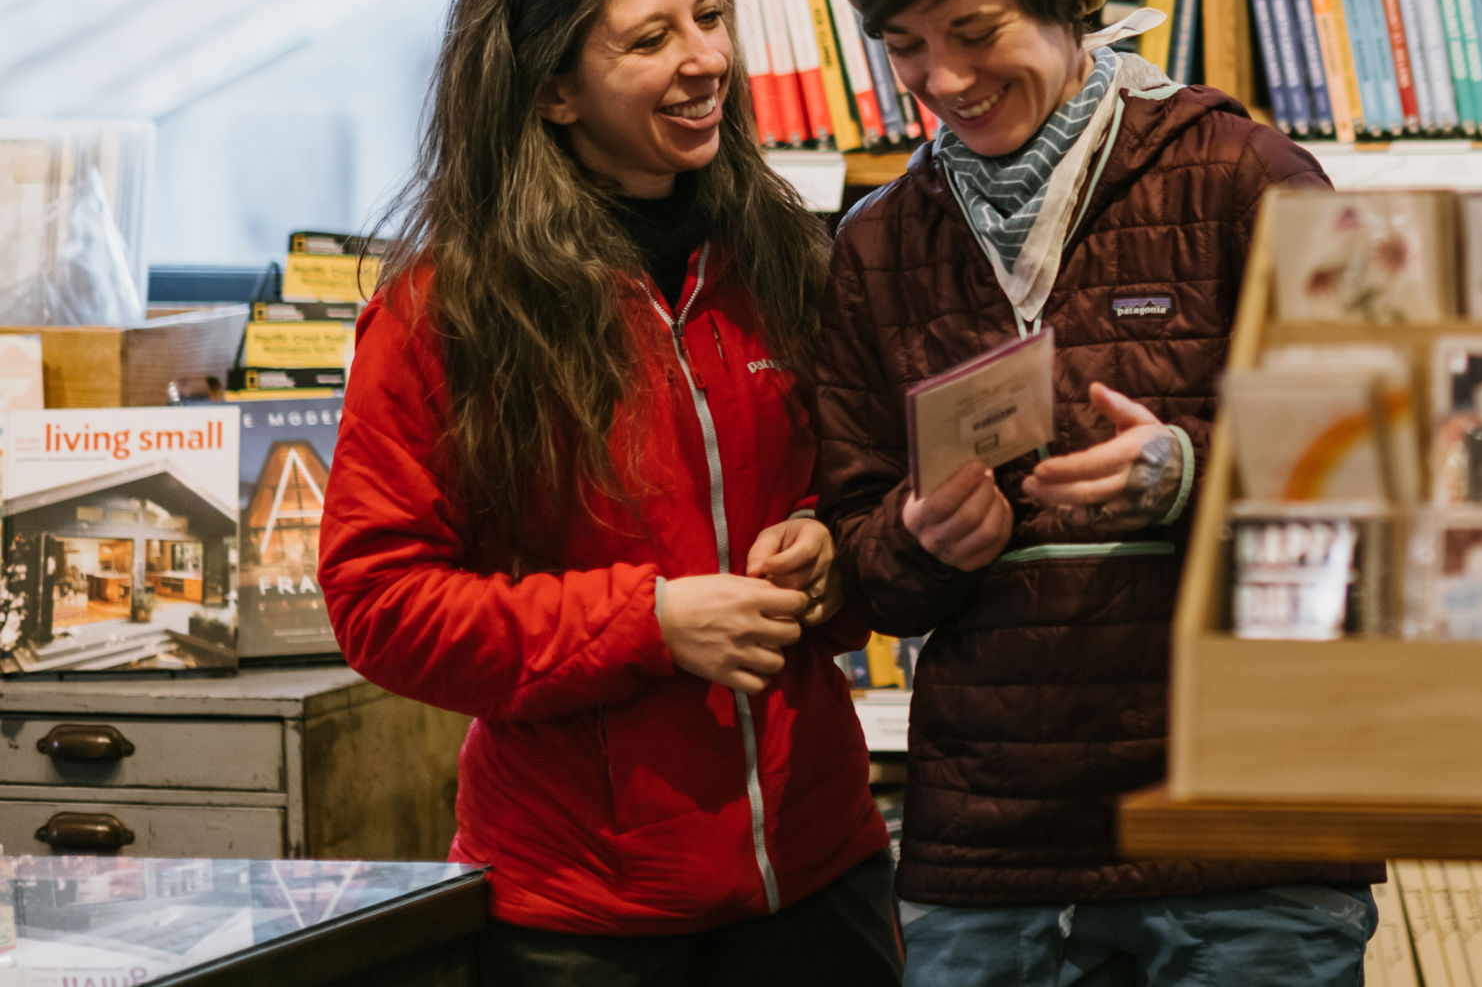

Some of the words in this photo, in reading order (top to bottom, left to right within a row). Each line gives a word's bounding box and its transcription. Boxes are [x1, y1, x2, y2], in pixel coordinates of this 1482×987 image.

[1117, 305, 1167, 317] patagonia
[45, 423, 131, 460] living
[139, 420, 223, 451] small
